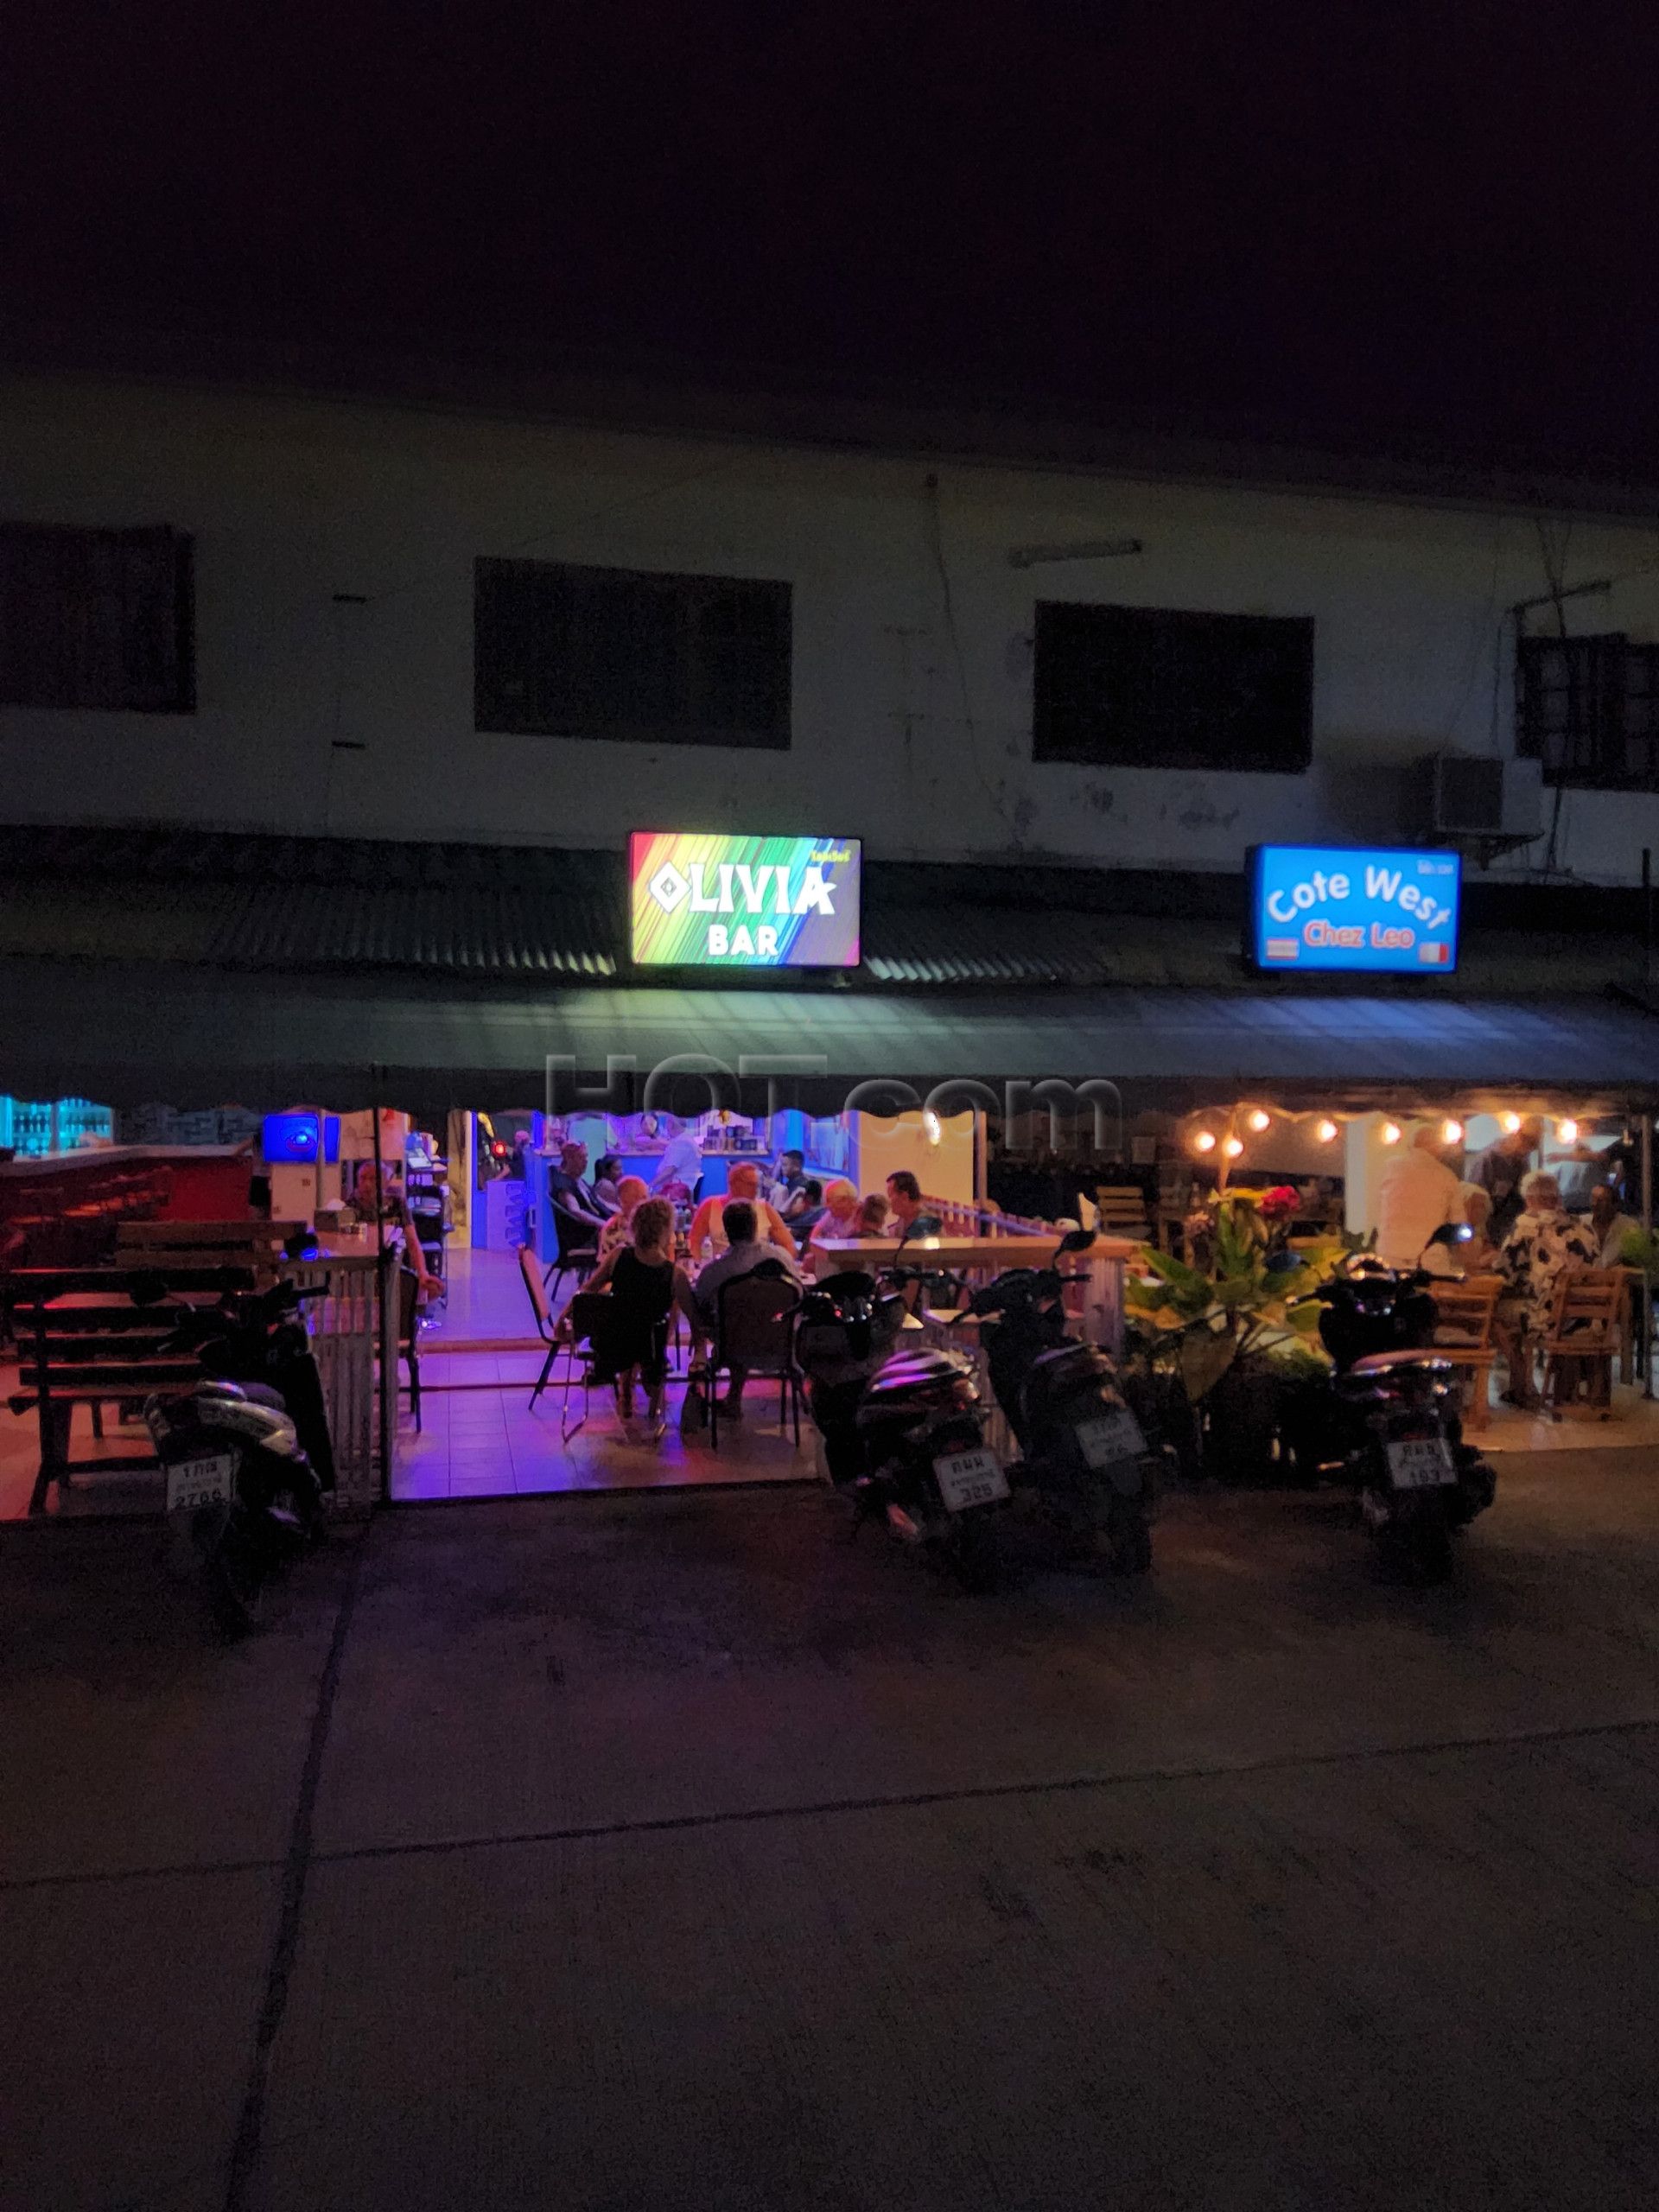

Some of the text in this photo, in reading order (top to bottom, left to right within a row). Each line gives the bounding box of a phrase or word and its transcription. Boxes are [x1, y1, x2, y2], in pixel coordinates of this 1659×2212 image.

[649, 861, 836, 914] OLIVIA
[1267, 865, 1452, 930] Cote West
[709, 924, 779, 957] BAR
[1303, 918, 1415, 949] Chez Leo
